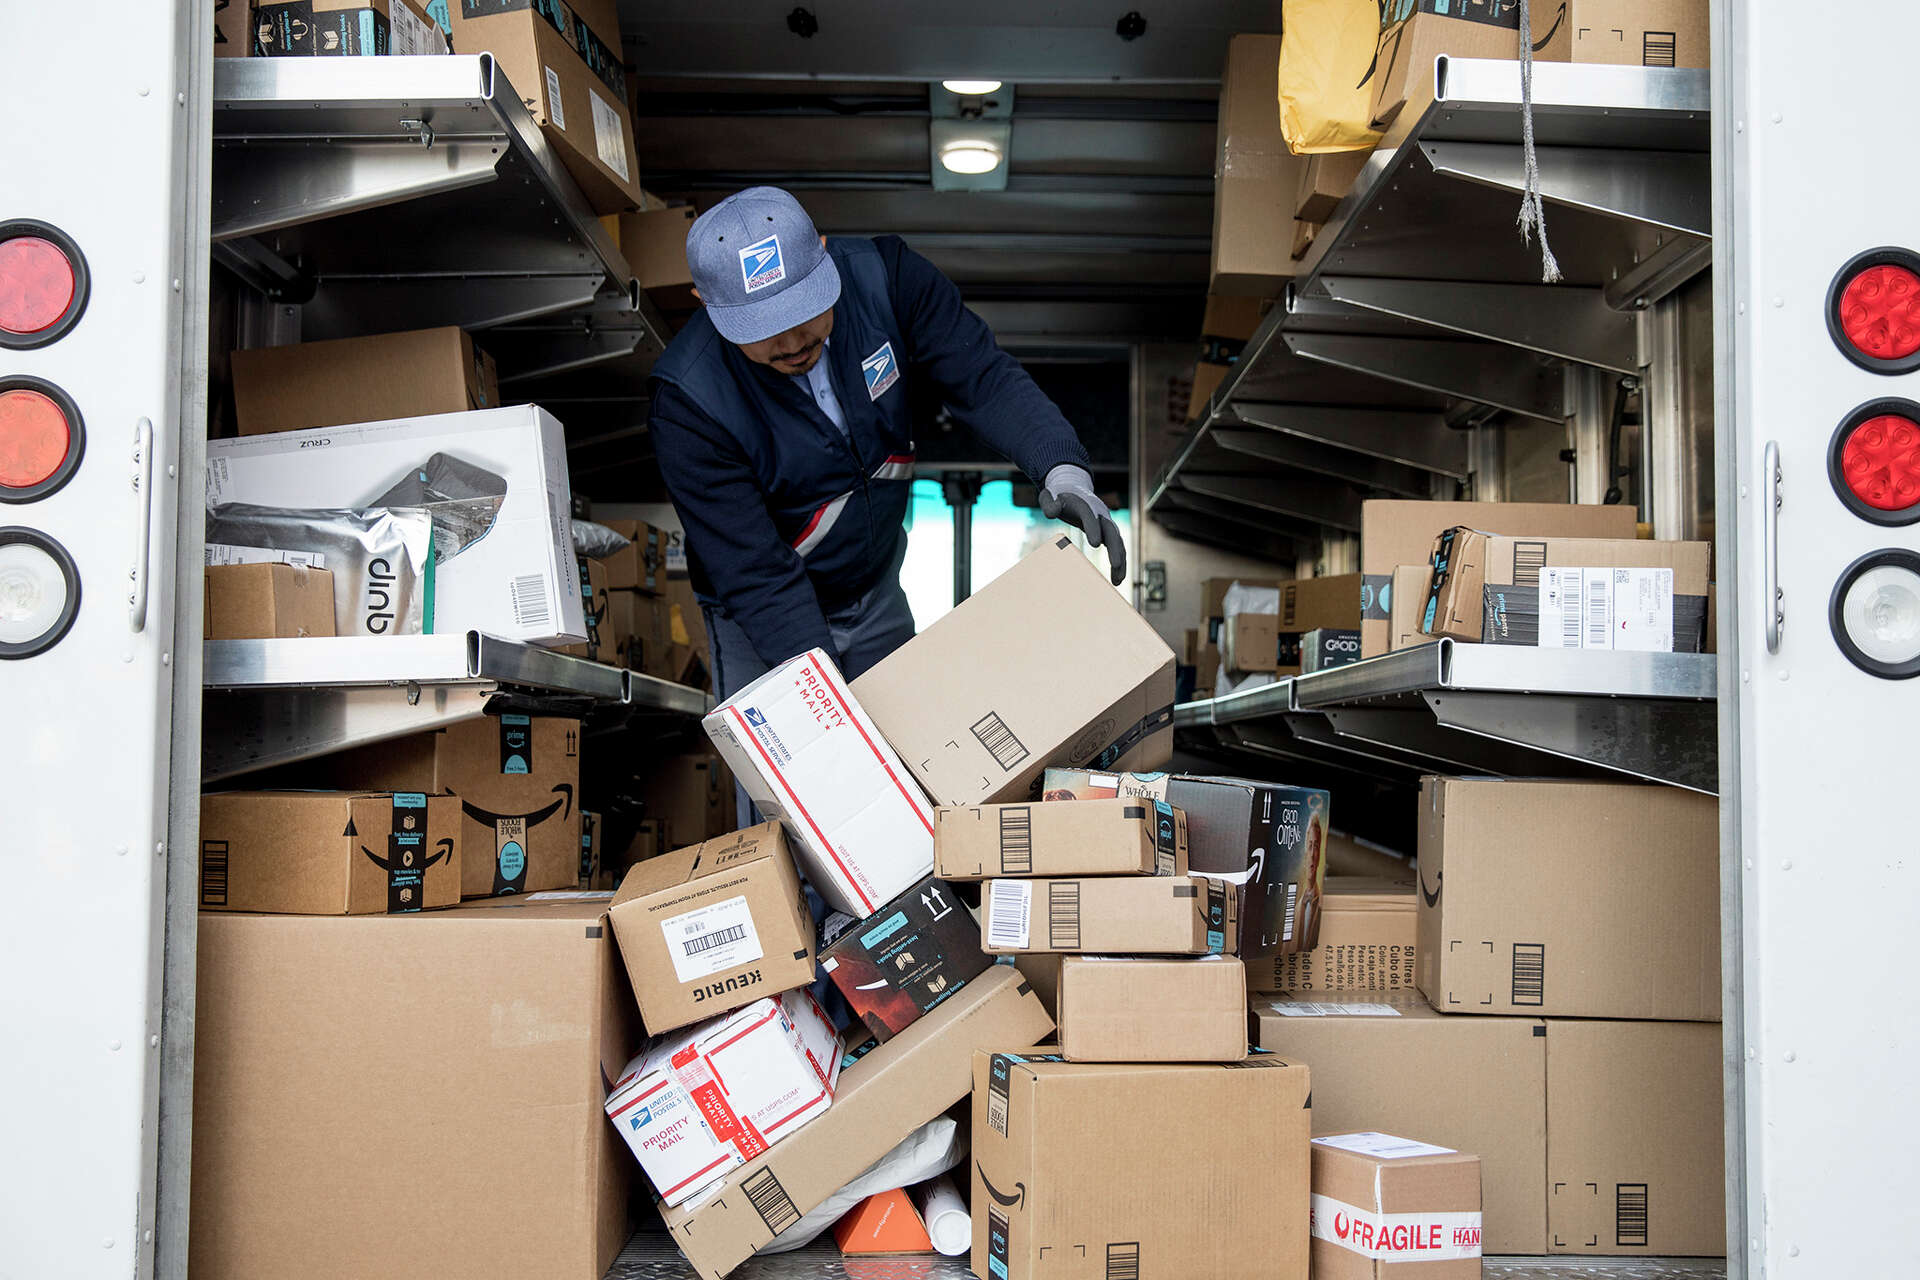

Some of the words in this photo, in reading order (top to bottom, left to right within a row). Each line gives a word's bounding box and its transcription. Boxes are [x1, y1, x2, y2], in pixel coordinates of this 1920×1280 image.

[300, 438, 331, 449] CRUZ
[366, 557, 396, 634] quip
[1325, 639, 1358, 652] GOOD
[800, 667, 847, 728] PRIORITY
[800, 689, 826, 722] MAIL
[755, 727, 771, 748] POSTAL
[764, 723, 780, 745] UNITED
[778, 743, 793, 761] STATES
[1125, 785, 1160, 800] WHOLE
[1336, 945, 1346, 974] Tamaño
[1347, 945, 1356, 963] Peso
[1357, 945, 1366, 963] Peso
[1378, 945, 1387, 967] Color:
[1390, 945, 1401, 971] Cubo
[1404, 945, 1415, 957] 50
[1366, 955, 1377, 971] caja
[1403, 958, 1415, 984] litres
[1336, 974, 1345, 984] de
[1357, 964, 1366, 984] neto:
[1390, 972, 1400, 985] de
[692, 969, 762, 1003] KEURIG
[649, 1090, 674, 1109] UNITED
[705, 1088, 734, 1128] PRIORITY
[653, 1102, 673, 1119] POSTAL
[705, 1102, 721, 1124] MAIL
[642, 1116, 689, 1150] PRIORITY
[658, 1134, 685, 1152] MAIL
[1352, 1218, 1442, 1251] FRAGILE
[1453, 1228, 1480, 1245] HAN
